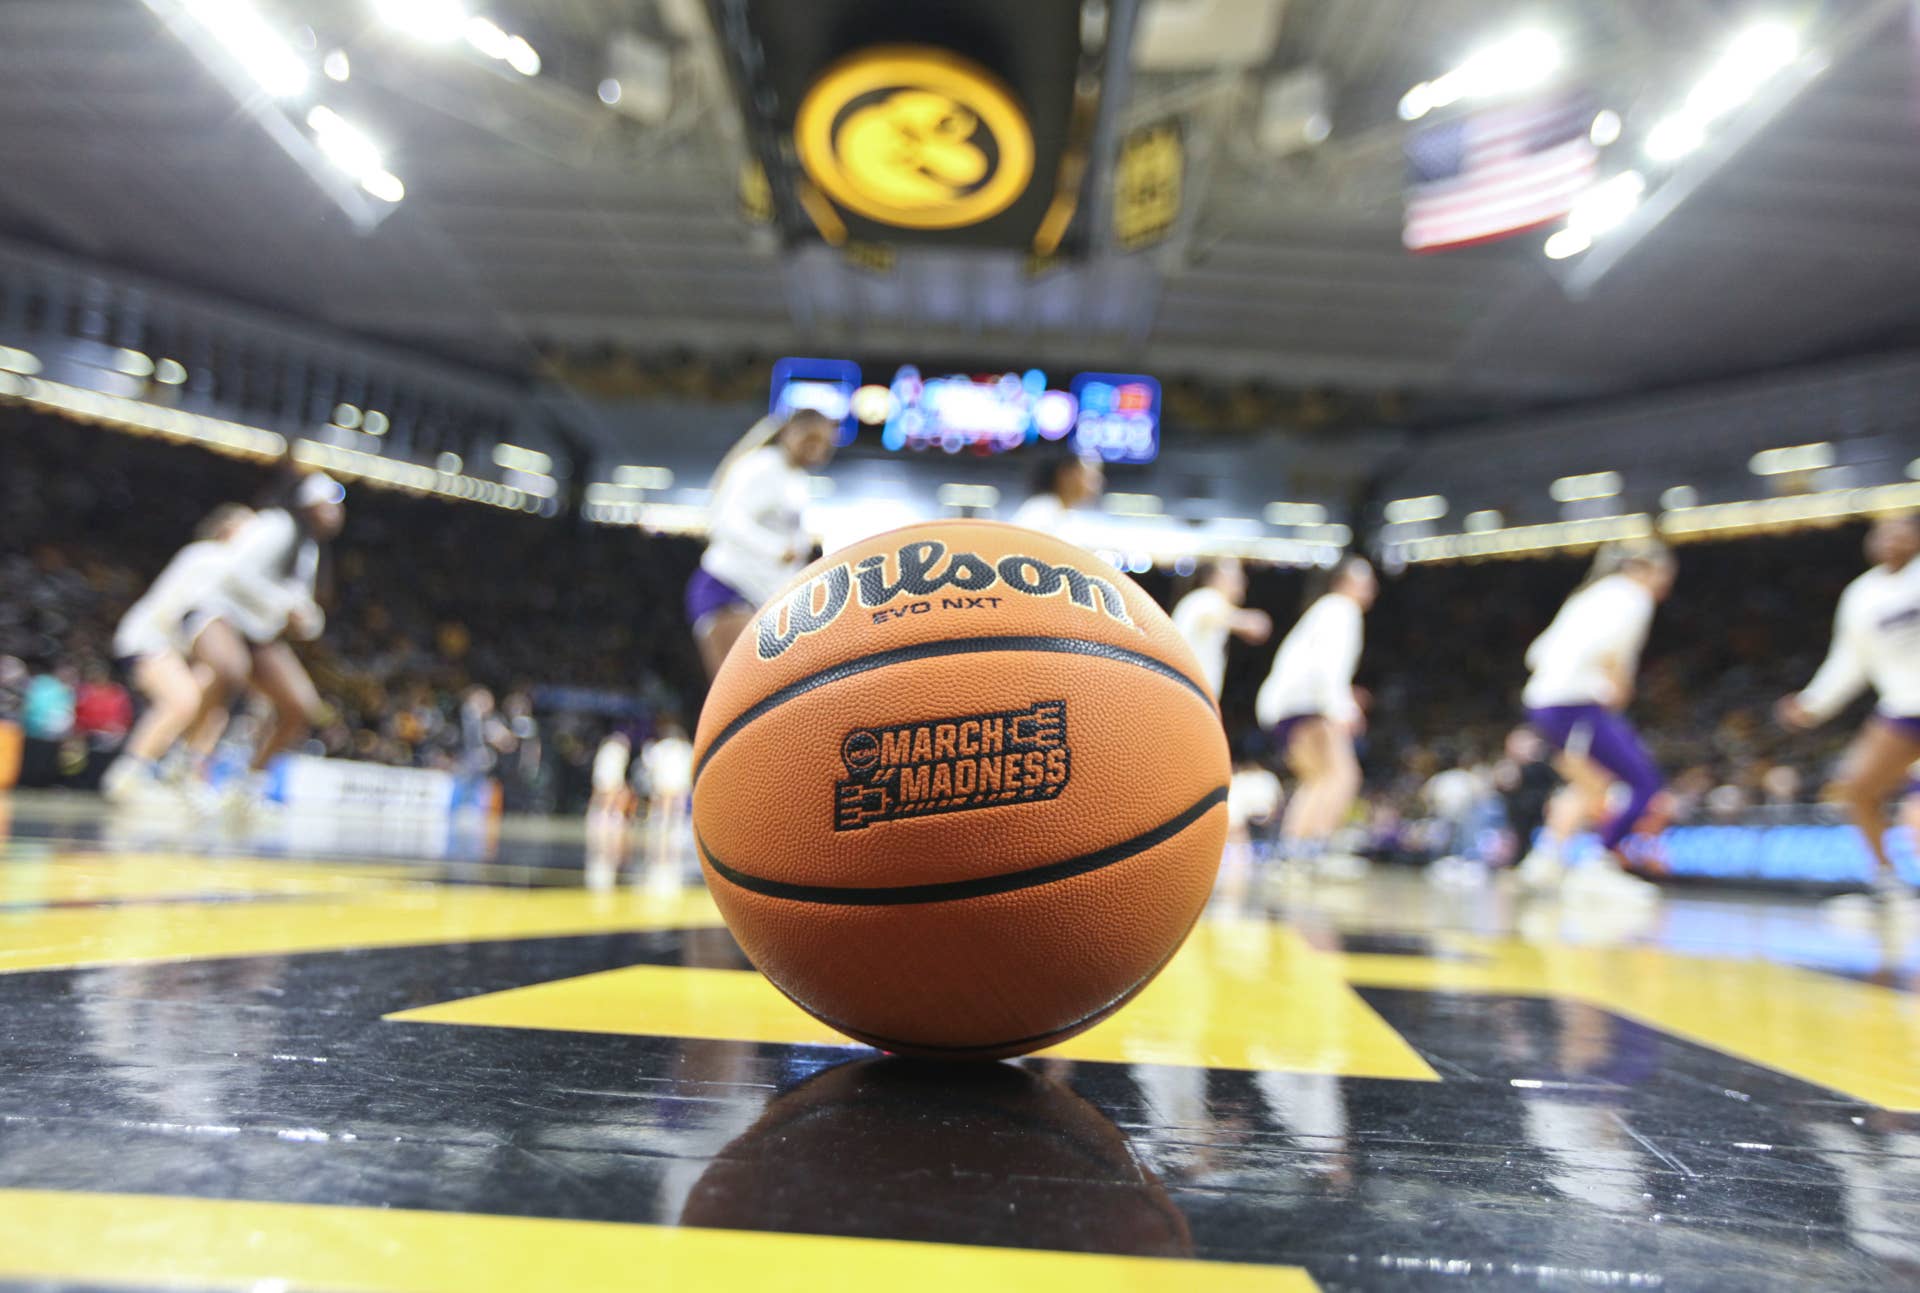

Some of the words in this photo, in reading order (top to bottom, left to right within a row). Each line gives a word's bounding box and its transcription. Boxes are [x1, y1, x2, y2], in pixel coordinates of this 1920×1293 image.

[754, 540, 1137, 661] Wilson
[872, 601, 931, 624] EVO
[942, 598, 1002, 610] NXT
[880, 718, 1004, 766] MARCH
[900, 749, 1067, 801] MADNESS
